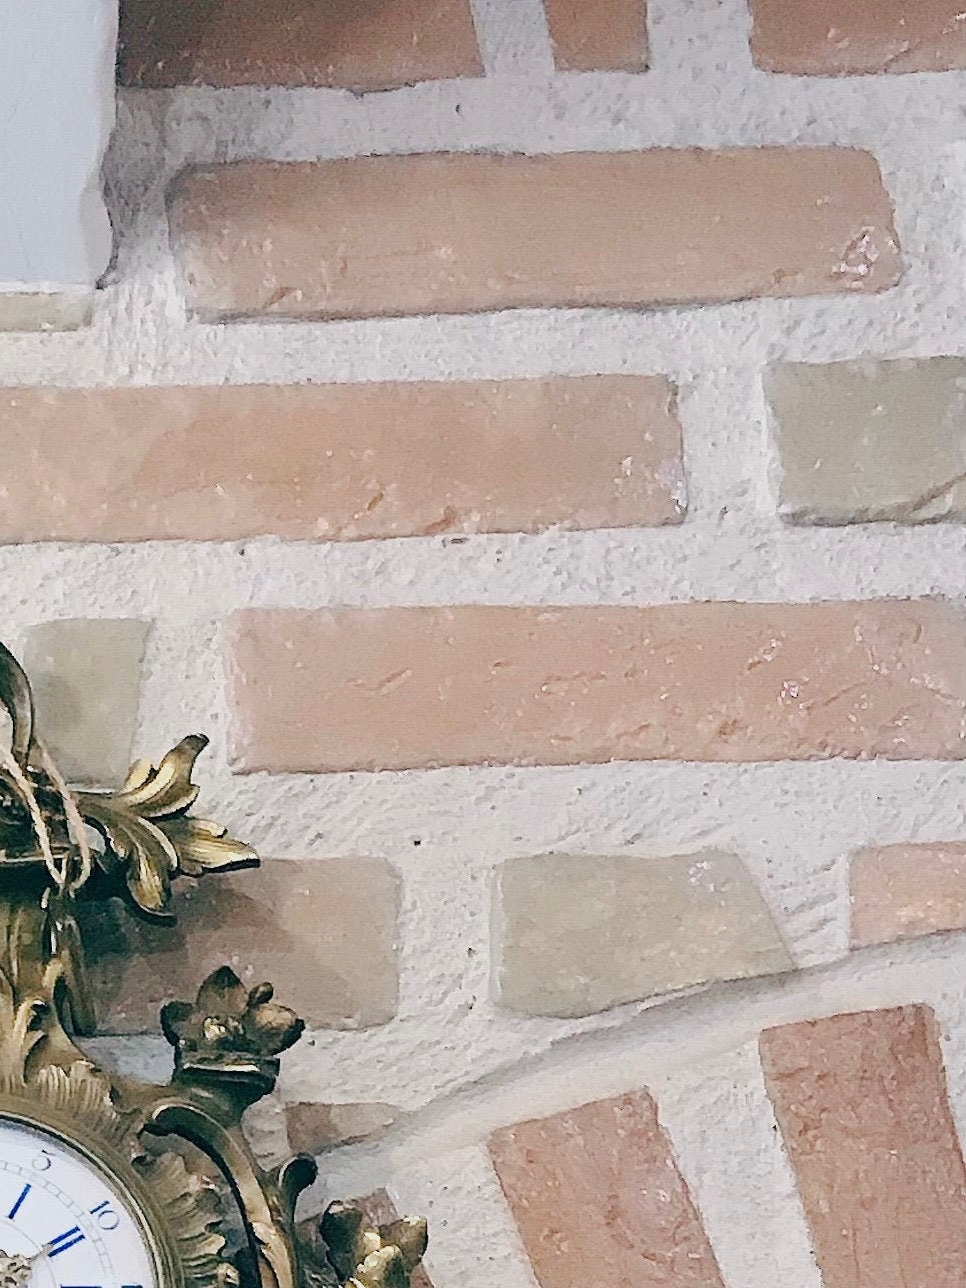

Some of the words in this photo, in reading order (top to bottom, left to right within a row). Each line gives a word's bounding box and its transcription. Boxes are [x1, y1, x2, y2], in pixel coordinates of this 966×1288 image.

[32, 1149, 56, 1171] 5
[7, 1183, 32, 1219] I
[89, 1200, 120, 1231] 10
[48, 1225, 85, 1257] II
